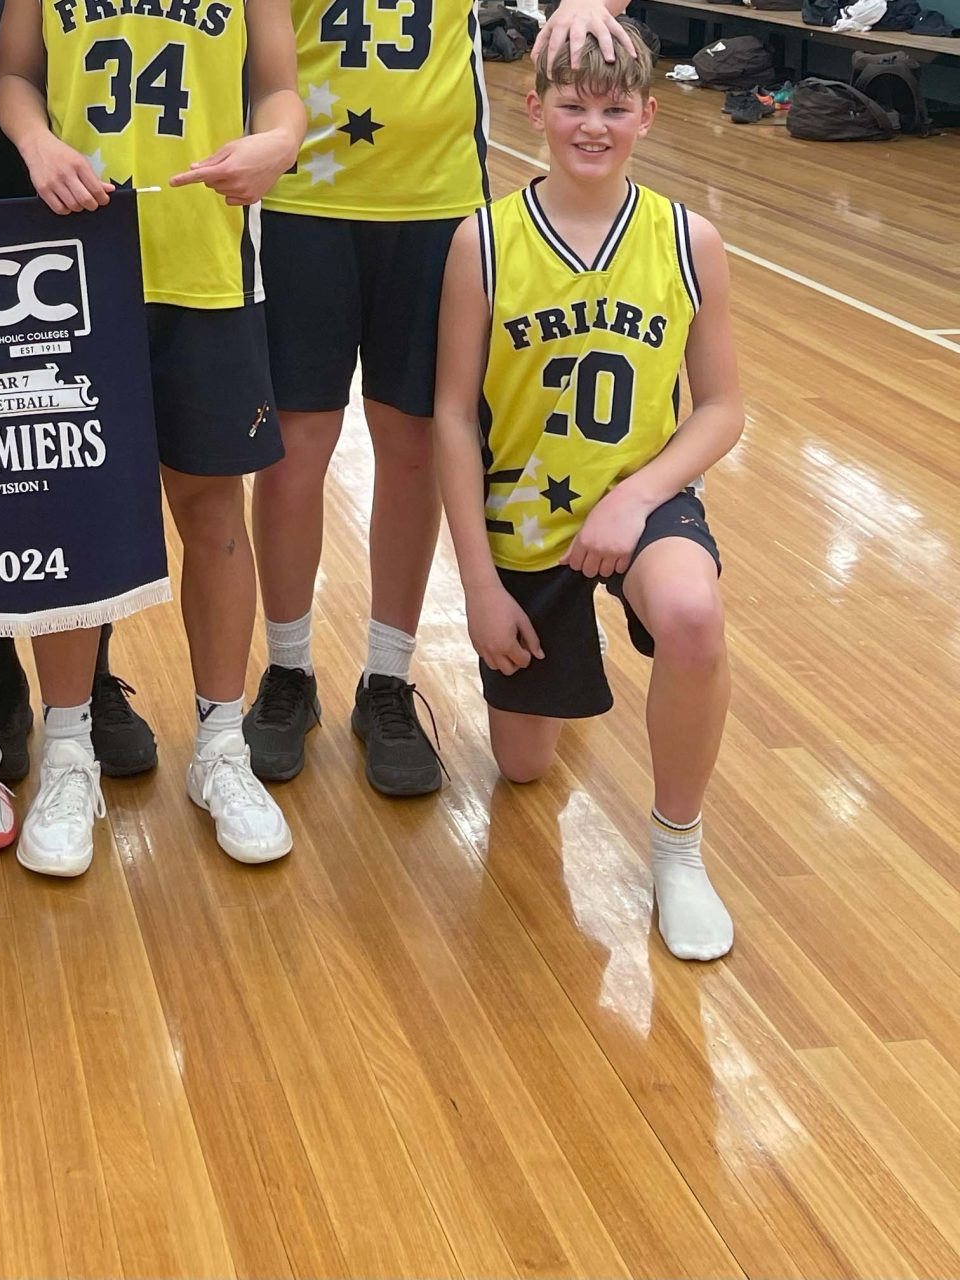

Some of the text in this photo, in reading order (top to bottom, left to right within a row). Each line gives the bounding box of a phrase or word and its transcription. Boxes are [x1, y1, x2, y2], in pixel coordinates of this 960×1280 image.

[84, 38, 190, 138] 34
[503, 297, 668, 351] FRIARS
[26, 330, 69, 341] COLLEGES
[41, 344, 62, 353] 1911
[22, 375, 30, 388] 7
[541, 350, 636, 445] 20
[42, 479, 49, 491] 1
